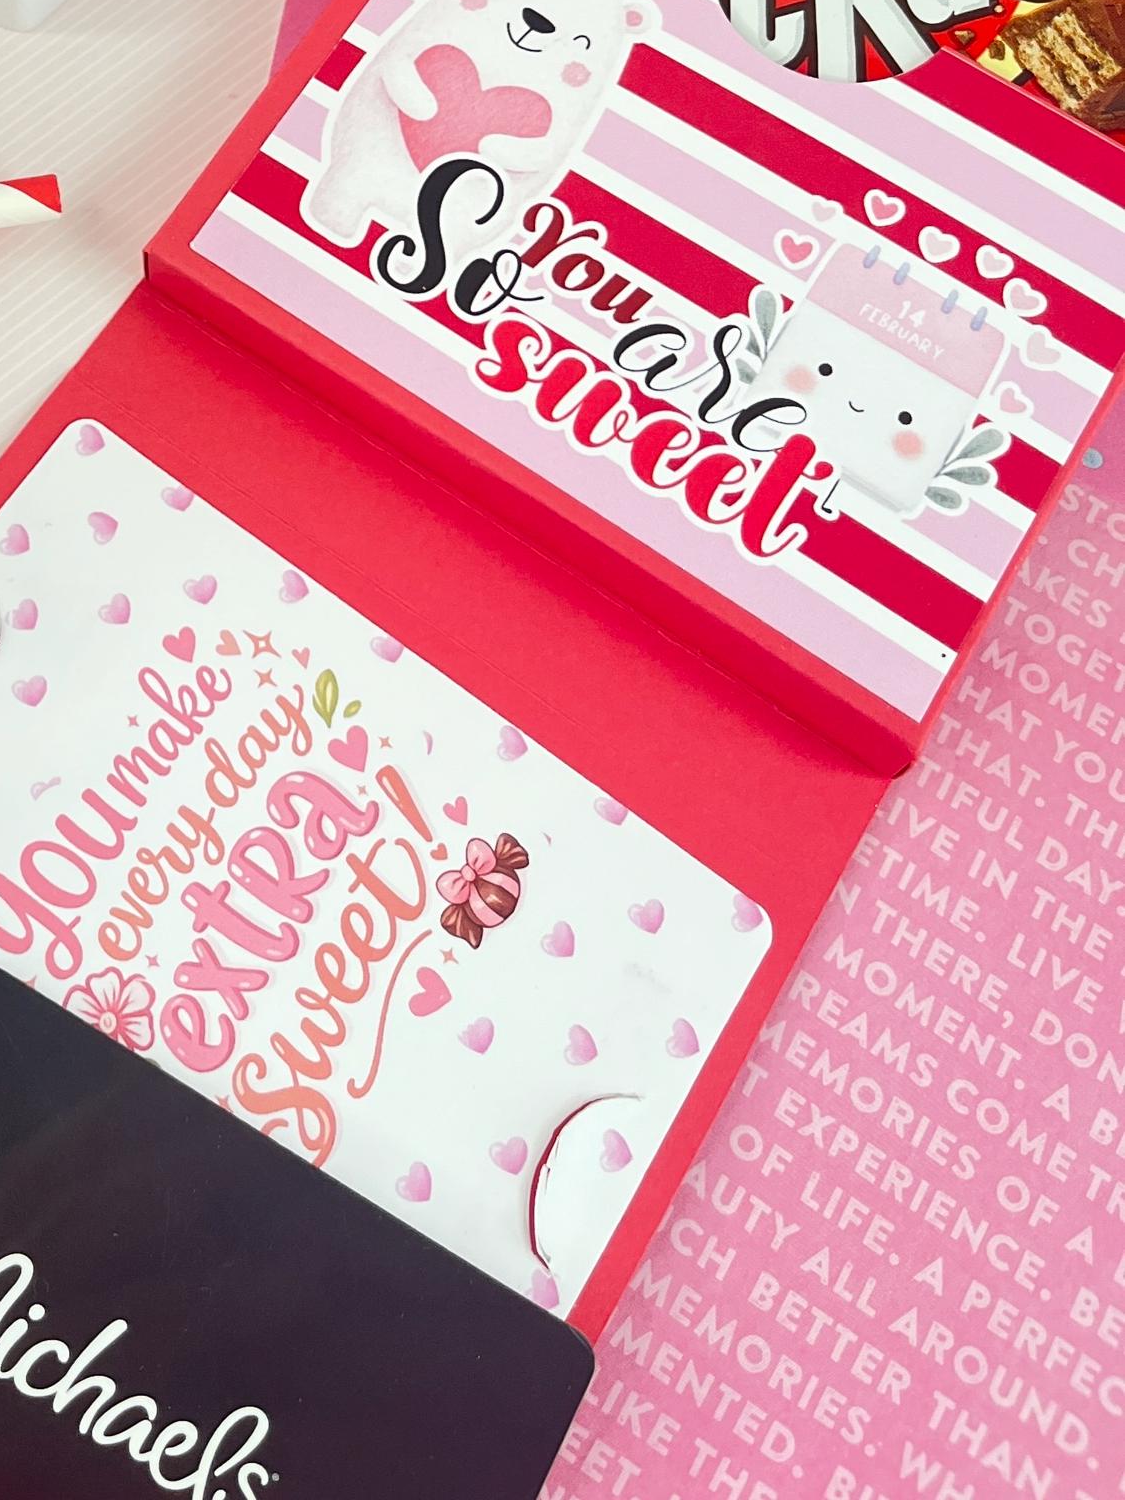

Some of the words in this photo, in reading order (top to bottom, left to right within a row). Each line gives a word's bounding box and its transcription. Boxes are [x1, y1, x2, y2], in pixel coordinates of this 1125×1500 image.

[378, 158, 544, 316] So
[521, 202, 645, 327] You
[898, 300, 927, 329] 14
[612, 323, 809, 453] are
[858, 302, 947, 359] FEBRUARY
[476, 320, 835, 559] sweet
[1068, 539, 1125, 588] CH
[105, 665, 232, 807] make
[938, 714, 1045, 807] THAT.
[1065, 793, 1125, 858] TH
[98, 805, 225, 961] every
[205, 684, 313, 808] day
[877, 797, 960, 861] IVE
[968, 849, 1018, 900] IN
[1031, 886, 1113, 961] THE
[917, 756, 1023, 851] TIFUL
[1035, 836, 1125, 916] DAY.
[823, 934, 1025, 1090] MOMENT.
[1042, 1084, 1070, 1122] A
[872, 899, 1014, 1028] THERE,
[1007, 933, 1103, 1014] LIVE
[790, 972, 938, 1087] REAMS
[947, 1079, 1077, 1182] COME
[730, 1125, 794, 1177] OF
[801, 1171, 900, 1265] LIFE.
[913, 1257, 943, 1296] A
[961, 1280, 1125, 1416] PERFEC
[774, 1087, 1051, 1301] EXPERIENCE.
[997, 1176, 1060, 1227] OF
[1065, 1226, 1093, 1265] A
[586, 1380, 681, 1456] IKE
[610, 1316, 803, 1478] MENTED.
[630, 1260, 875, 1456] MEMORIES.
[658, 1211, 736, 1281] CH
[748, 1271, 911, 1405] BETTER
[928, 1391, 1054, 1500] THAN
[800, 1246, 876, 1318] ALL
[888, 1307, 1099, 1471] AROUND.
